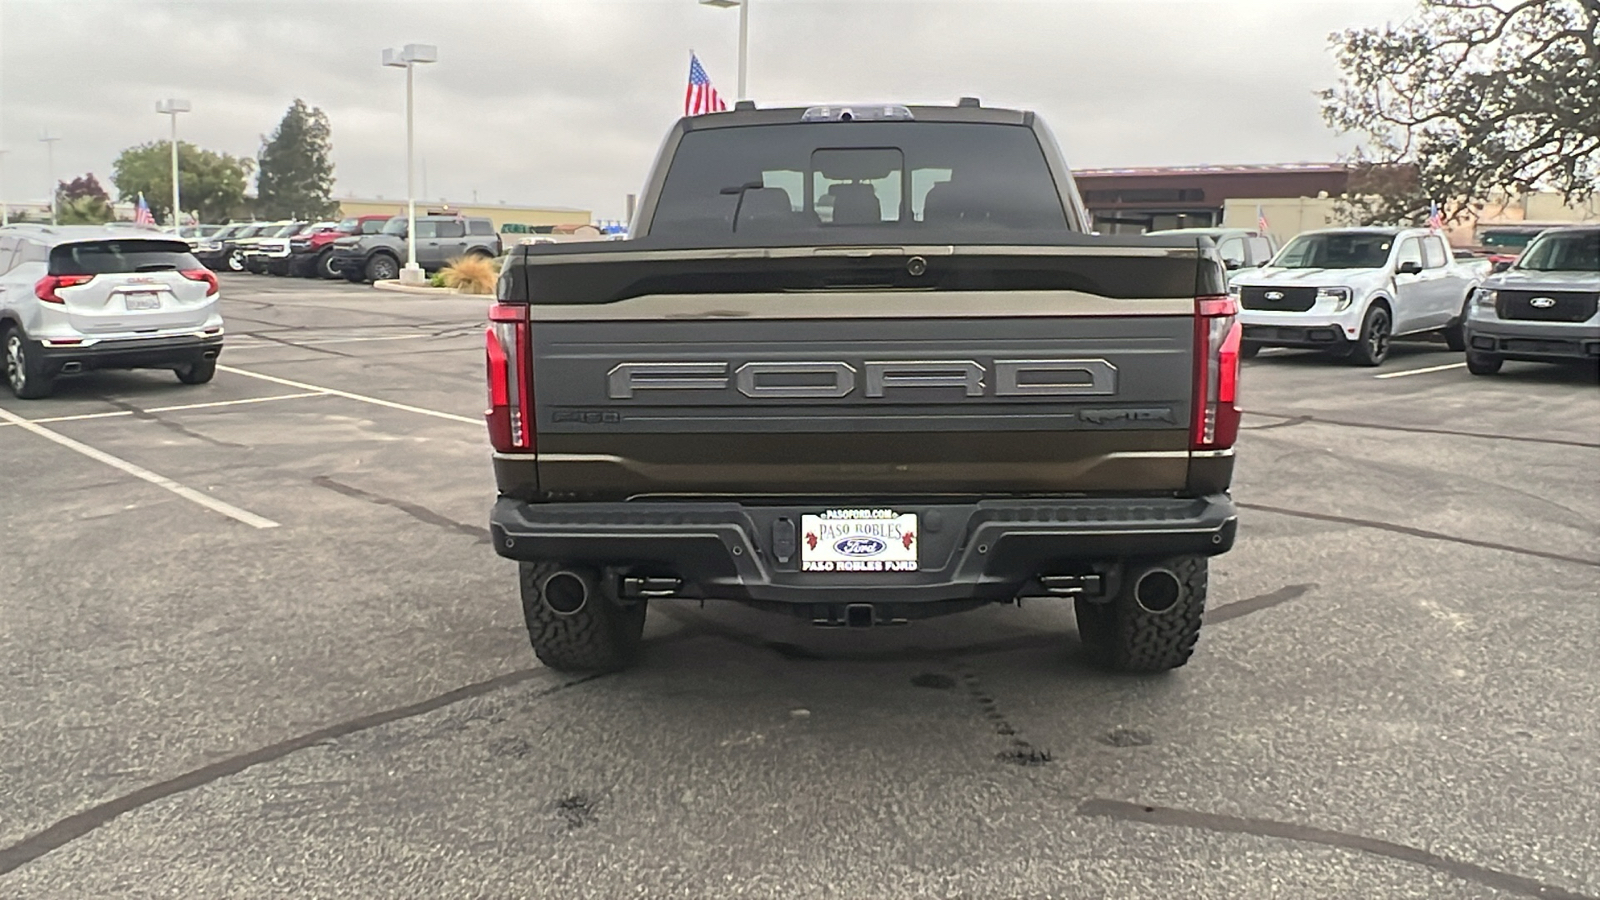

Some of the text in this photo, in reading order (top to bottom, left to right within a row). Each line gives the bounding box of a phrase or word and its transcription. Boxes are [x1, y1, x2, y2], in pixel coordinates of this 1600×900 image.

[607, 357, 1118, 399] FORD
[819, 523, 902, 541] PASO ROBLES
[843, 540, 877, 553] Ford
[802, 561, 918, 571] PASO ROBLES FORD
